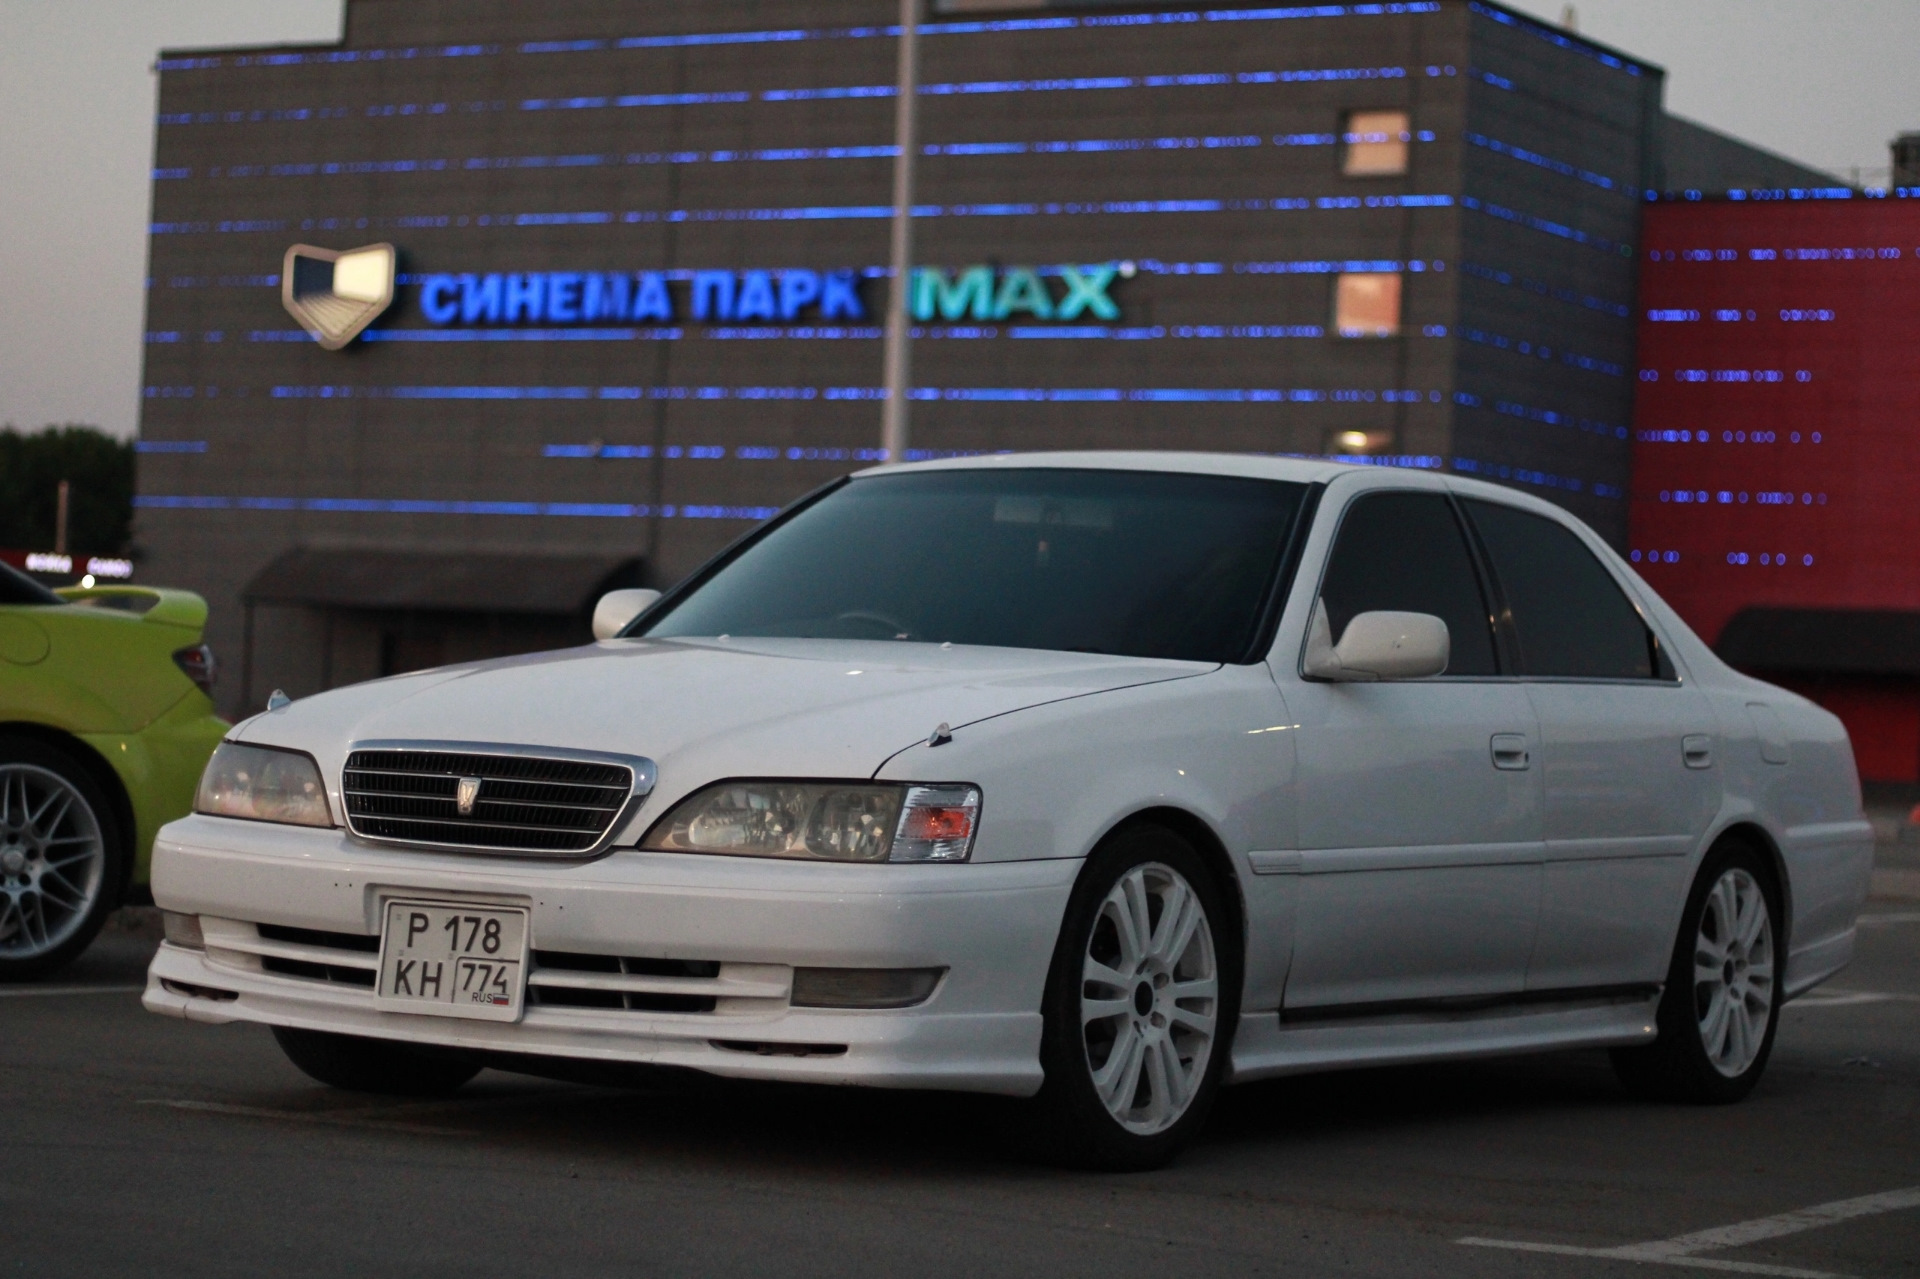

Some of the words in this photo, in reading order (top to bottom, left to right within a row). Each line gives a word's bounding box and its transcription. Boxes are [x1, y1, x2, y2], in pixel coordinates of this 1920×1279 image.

[420, 270, 673, 324] СИНЕМА
[690, 268, 865, 321] ПАРК
[905, 265, 1119, 321] MAX
[444, 915, 501, 954] 178
[462, 963, 507, 994] 774
[472, 991, 493, 1004] RUS
